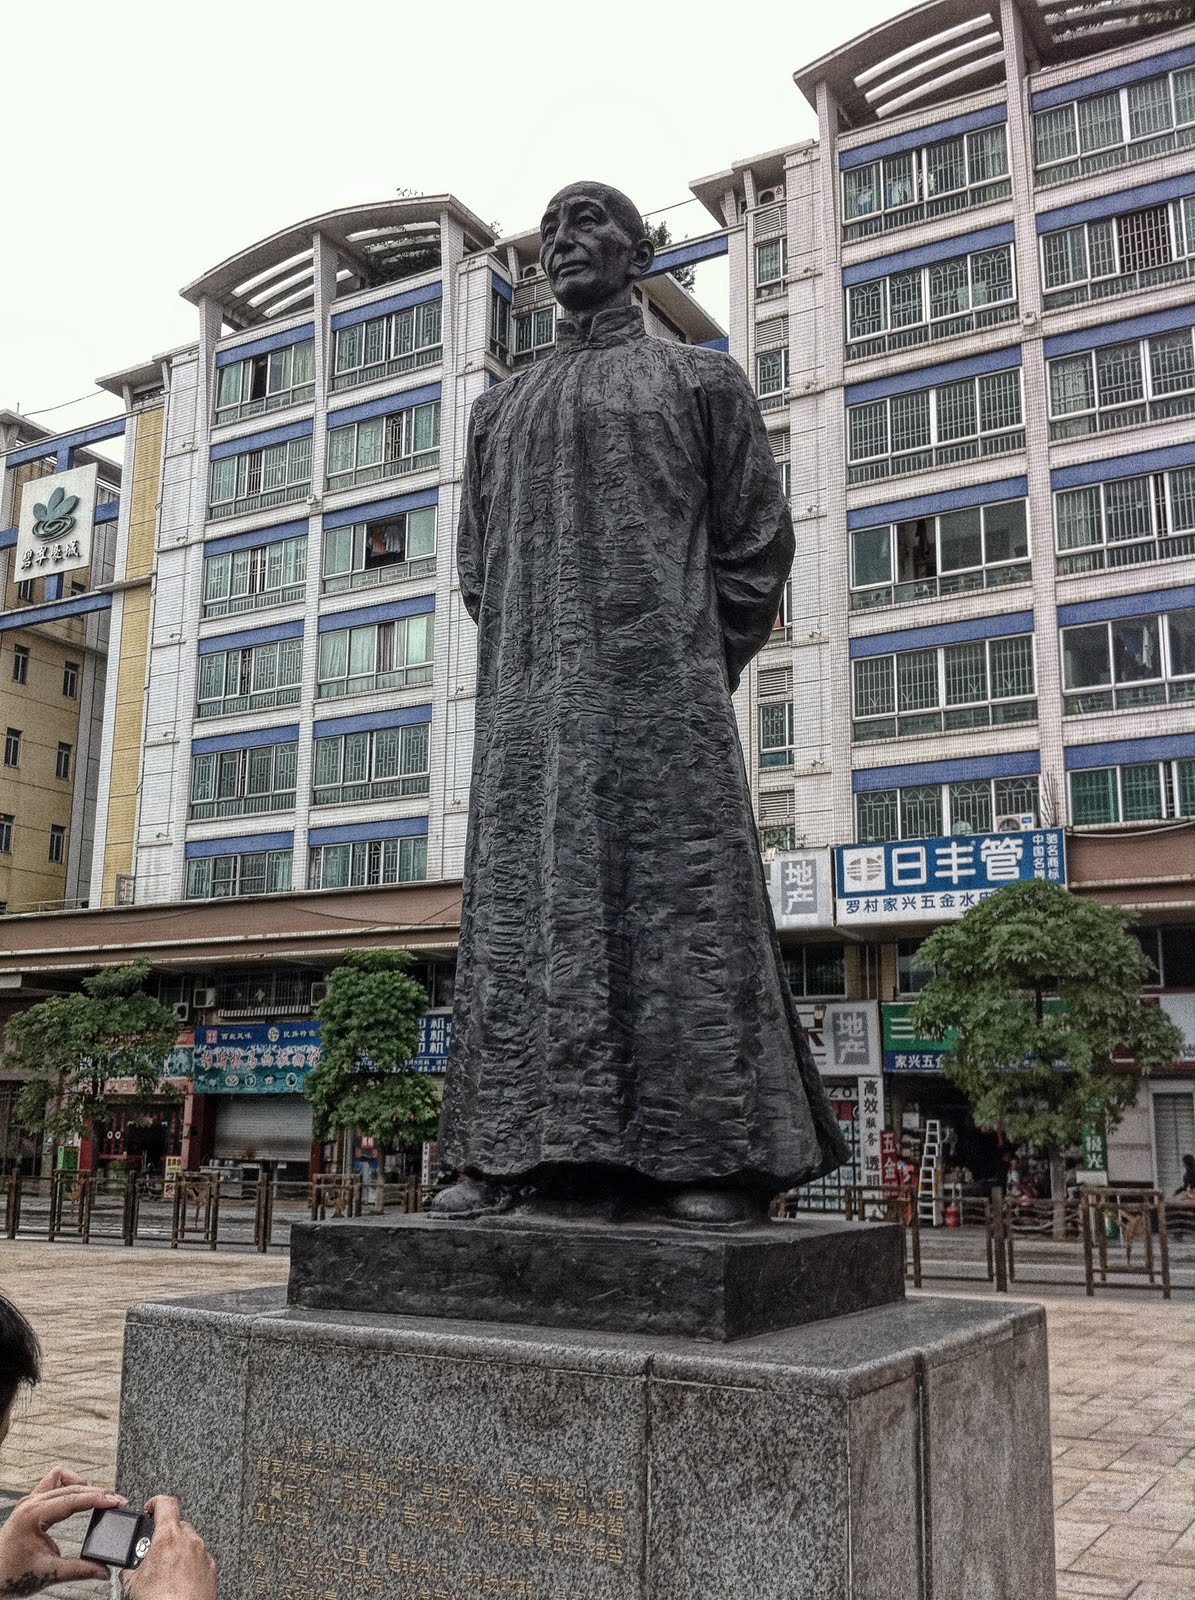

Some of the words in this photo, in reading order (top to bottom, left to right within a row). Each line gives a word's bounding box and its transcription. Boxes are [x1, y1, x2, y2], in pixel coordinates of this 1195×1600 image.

[891, 837, 1023, 886] 日丰管
[784, 860, 814, 914] 地产
[836, 1012, 866, 1063] 地产
[883, 1133, 897, 1180] 五金
